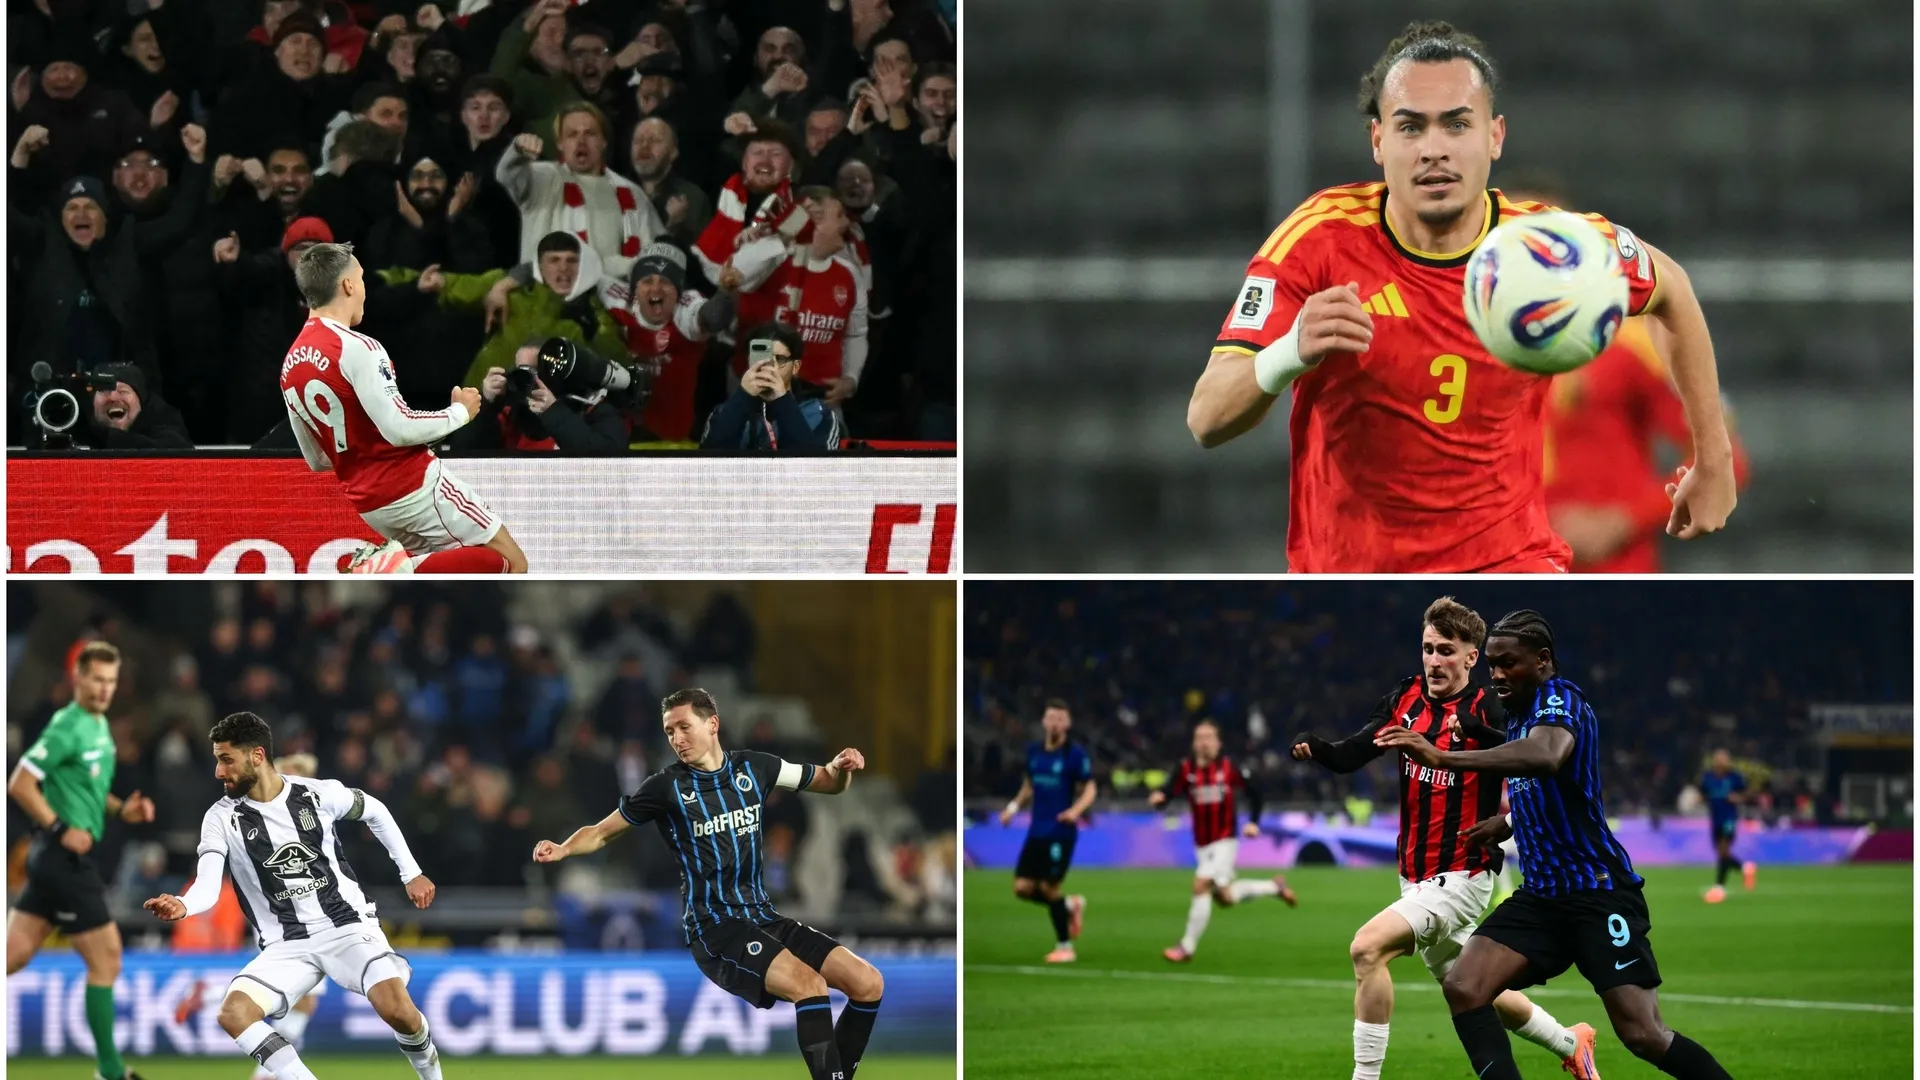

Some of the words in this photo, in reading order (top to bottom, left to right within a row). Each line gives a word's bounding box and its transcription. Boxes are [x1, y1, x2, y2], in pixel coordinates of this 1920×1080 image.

[1423, 354, 1468, 424] 3
[284, 379, 348, 453] 19
[1405, 761, 1418, 779] FLY
[1418, 766, 1456, 786] BETTER
[693, 804, 761, 837] betFIRST
[275, 876, 329, 900] NAPOLEON
[1608, 913, 1631, 947] 9
[424, 967, 669, 1056] CLUB
